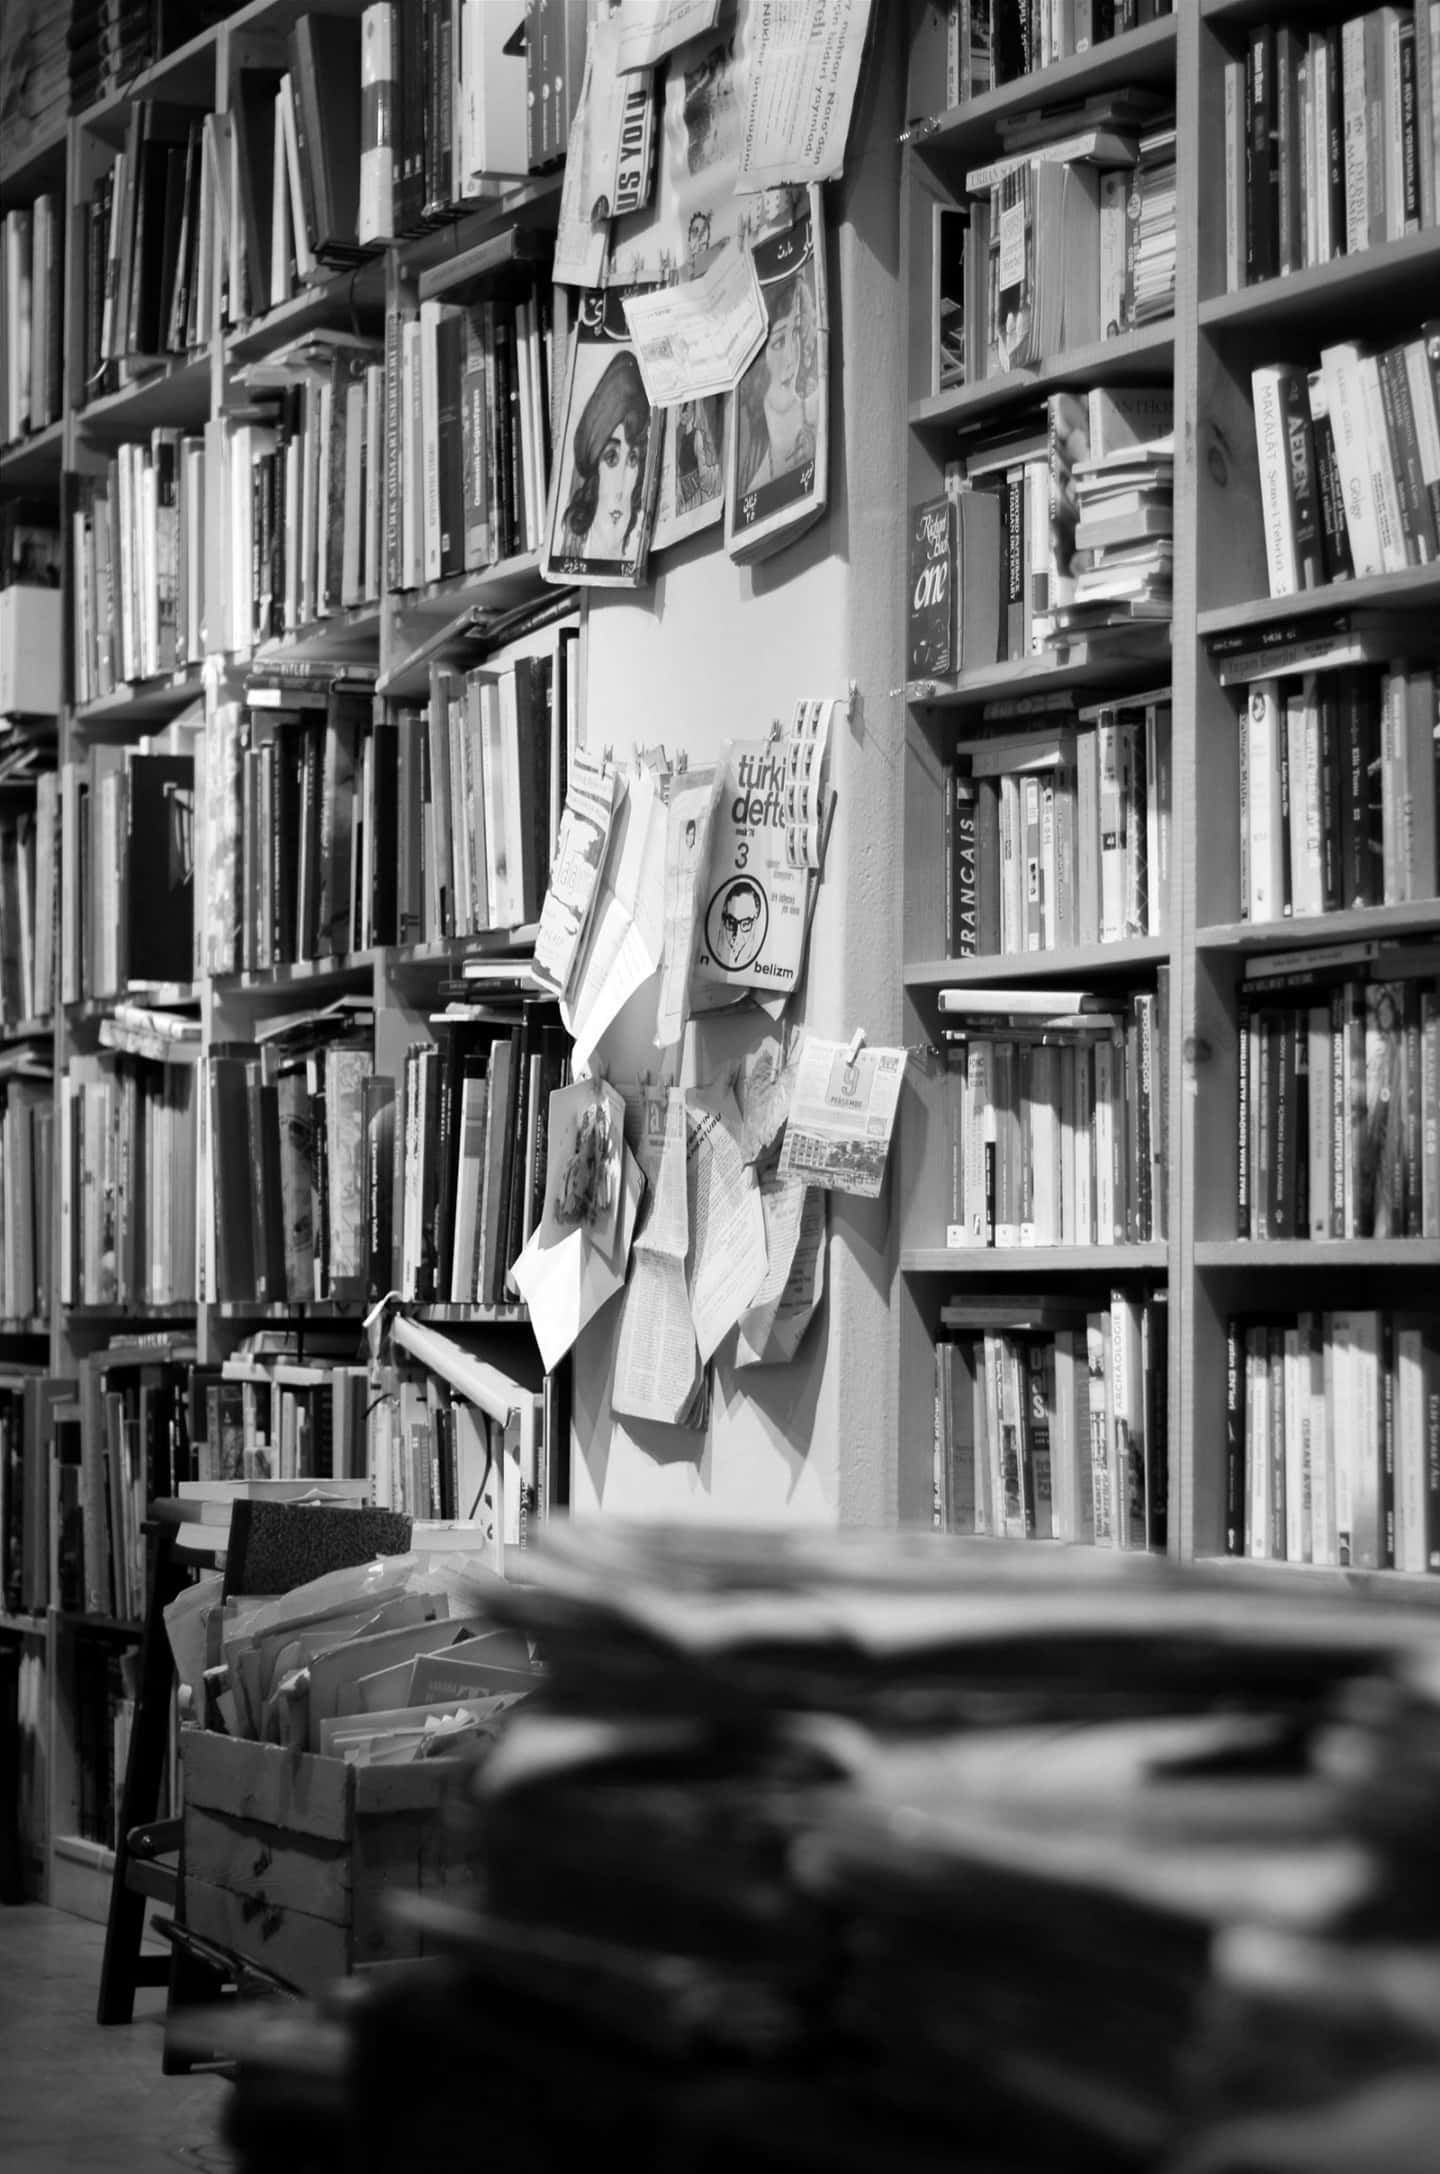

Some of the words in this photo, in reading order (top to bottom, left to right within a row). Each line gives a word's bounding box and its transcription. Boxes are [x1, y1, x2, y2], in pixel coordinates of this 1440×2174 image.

[619, 90, 647, 163] YOLU
[386, 501, 397, 549] TÜRK
[913, 560, 948, 611] one
[737, 754, 786, 792] türki
[731, 790, 786, 828] defte
[734, 842, 750, 869] 3
[754, 961, 794, 980] belizm
[840, 1063, 861, 1097] 9
[1303, 1417, 1312, 1469] OSMAN
